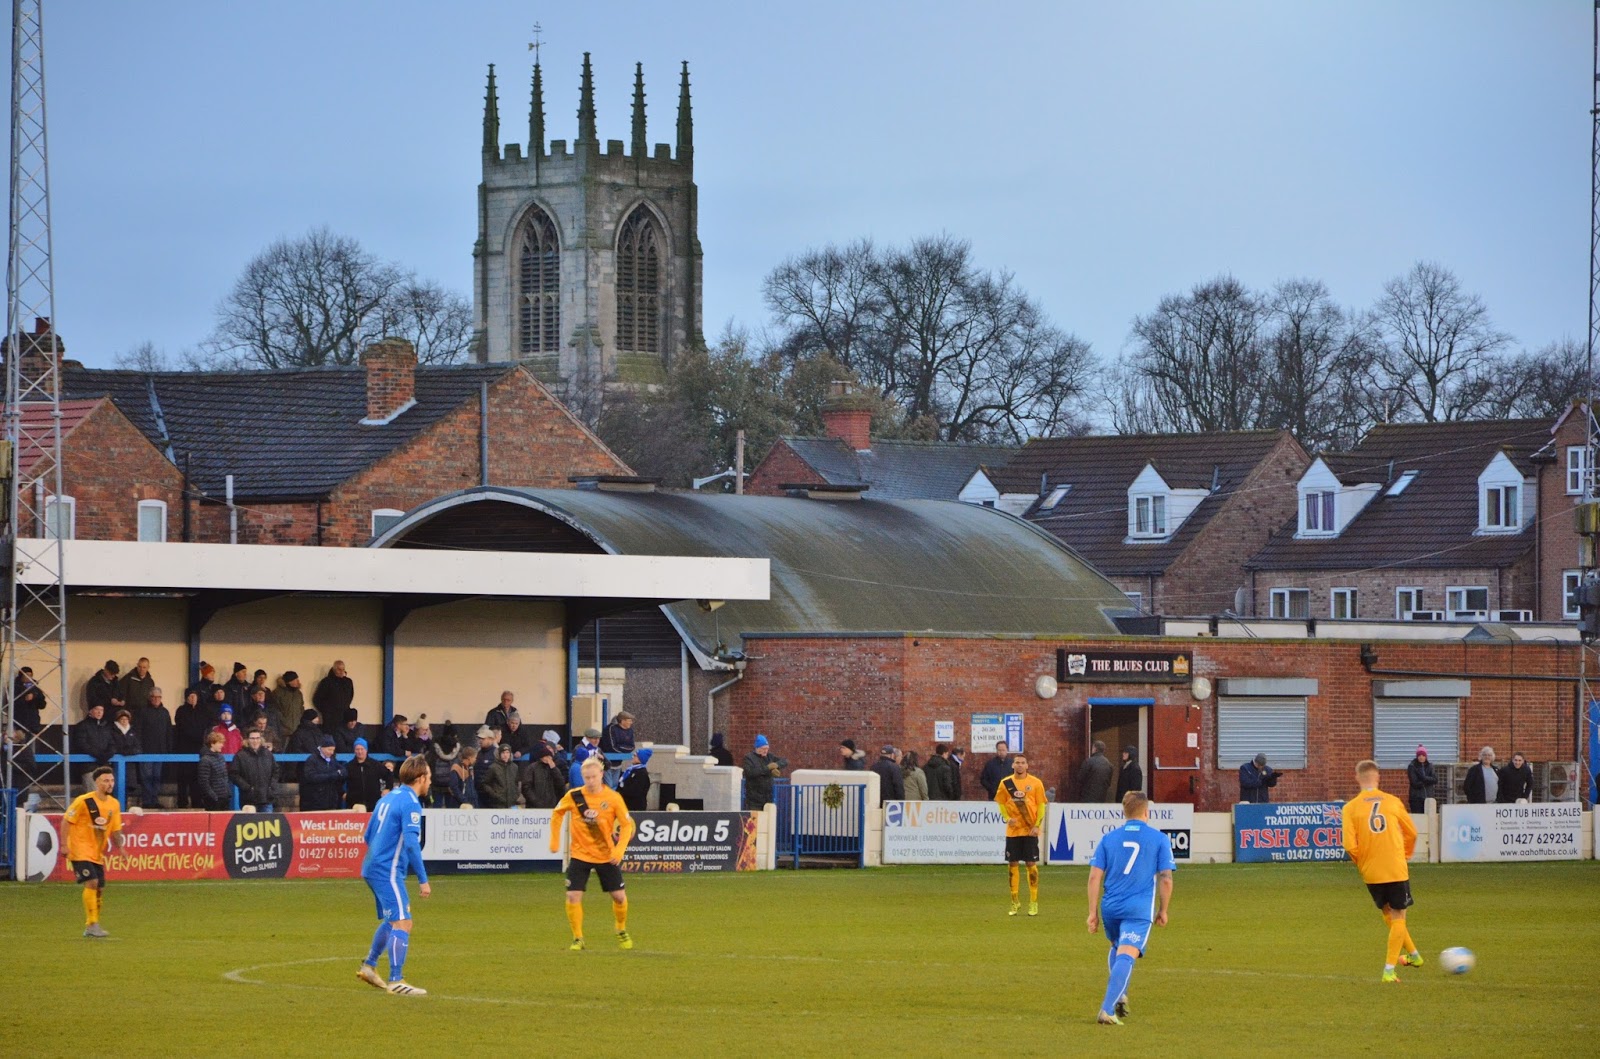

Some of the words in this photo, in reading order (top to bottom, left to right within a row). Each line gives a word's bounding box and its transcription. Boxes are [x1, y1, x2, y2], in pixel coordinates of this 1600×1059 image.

[1091, 660, 1110, 671] THE
[1113, 661, 1143, 672] BLUES
[1144, 660, 1170, 672] CLUB
[1148, 809, 1174, 820] TYRE
[1275, 805, 1322, 816] JOHNSONS
[1496, 809, 1512, 819] HOT
[1514, 809, 1529, 819] TUB
[1531, 808, 1549, 818] HIRE
[1549, 809, 1557, 818] &
[1557, 807, 1581, 818] SALES
[377, 803, 390, 834] 4
[443, 814, 479, 828] LUCAS
[490, 814, 520, 826] Online
[1264, 815, 1322, 827] TRADITIONAL
[1368, 801, 1387, 834] 6
[300, 819, 326, 831] West
[328, 819, 365, 834] Lindsey
[637, 819, 709, 842] Salon
[713, 819, 730, 843] 5
[1470, 826, 1481, 834] hot
[235, 819, 281, 848] JOIN
[300, 833, 336, 845] Leisure
[442, 829, 479, 842] FETTES
[490, 829, 506, 840] and
[507, 828, 542, 840] financial
[1240, 829, 1291, 849] FISH
[1292, 827, 1310, 848] &
[1312, 828, 1344, 848] CH
[1470, 834, 1483, 843] tubs
[1502, 833, 1533, 846] 01427
[1536, 833, 1574, 845] 629234
[151, 832, 216, 848] ACTIVE
[235, 846, 266, 865] FOR
[268, 843, 282, 861] £1
[299, 847, 325, 860] 01427
[327, 846, 360, 859] 615169
[443, 847, 460, 856] online
[490, 845, 524, 855] services
[891, 849, 911, 857] 01427
[1271, 852, 1286, 862] TEL:
[1287, 850, 1312, 862] 01427
[1314, 848, 1346, 861] 679967
[1499, 848, 1579, 857] www.aahottubs.co.uk
[700, 853, 729, 861] WEDDINGS
[1123, 841, 1140, 875] 7
[242, 865, 258, 873] Quote
[621, 861, 641, 873] 427
[643, 861, 683, 873] 677888
[689, 861, 704, 873] ghd
